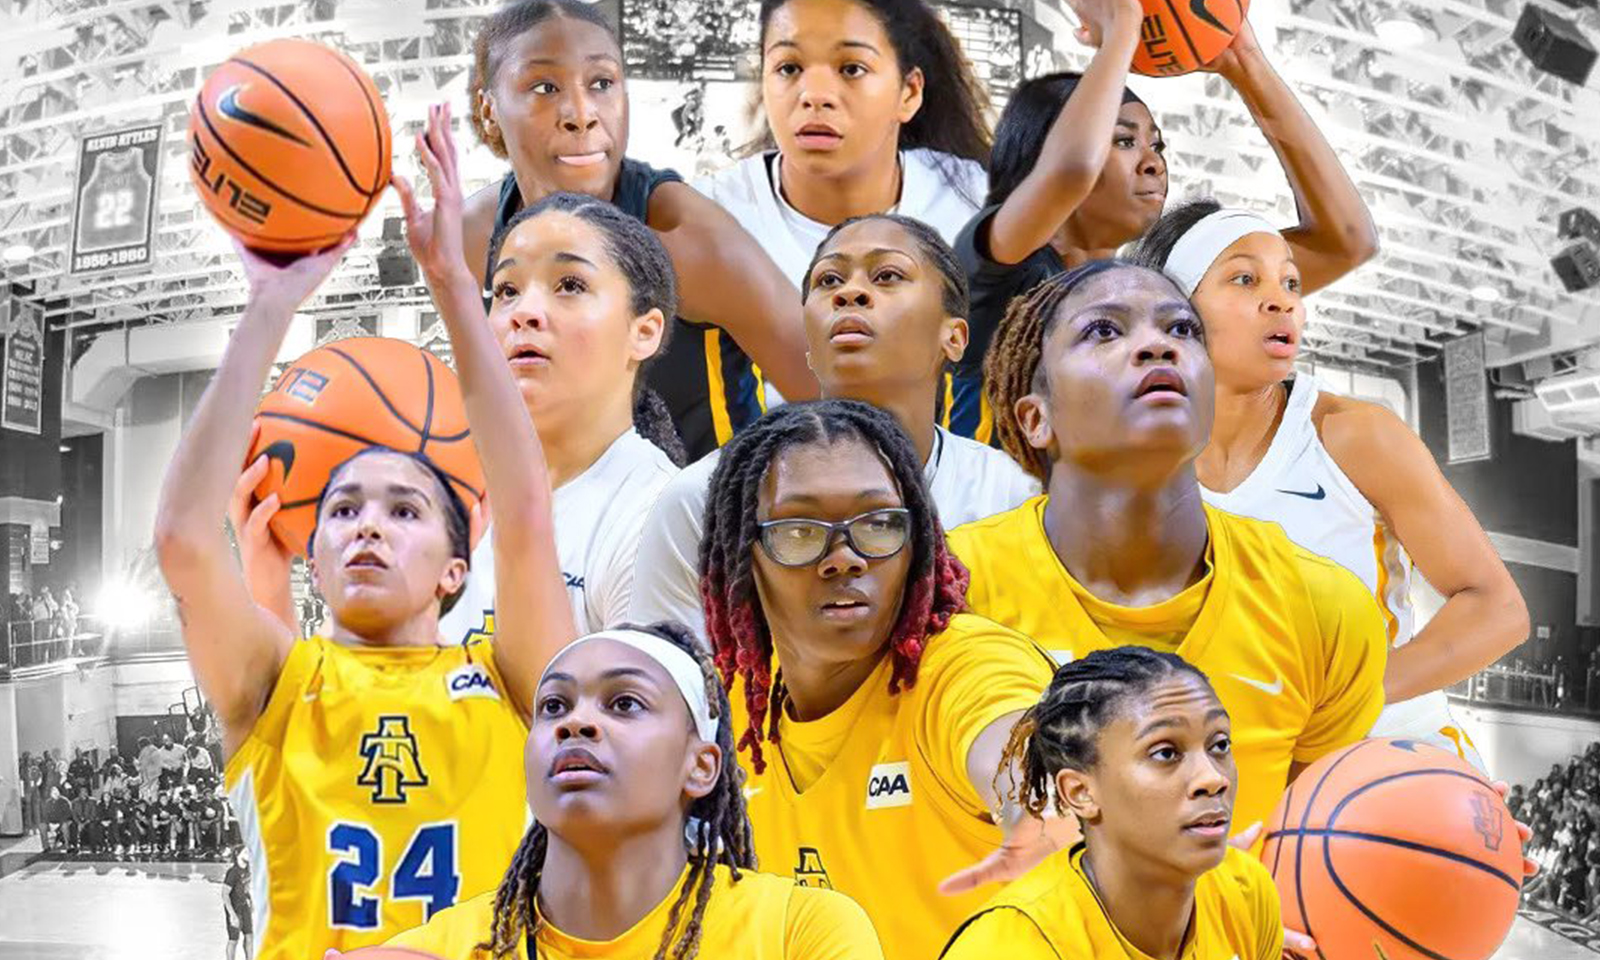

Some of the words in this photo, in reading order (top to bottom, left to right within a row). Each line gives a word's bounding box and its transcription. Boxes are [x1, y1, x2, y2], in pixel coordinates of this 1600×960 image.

[95, 189, 134, 228] 22
[192, 131, 271, 224] ELITE
[868, 773, 910, 797] CAA
[327, 820, 462, 932] 24
